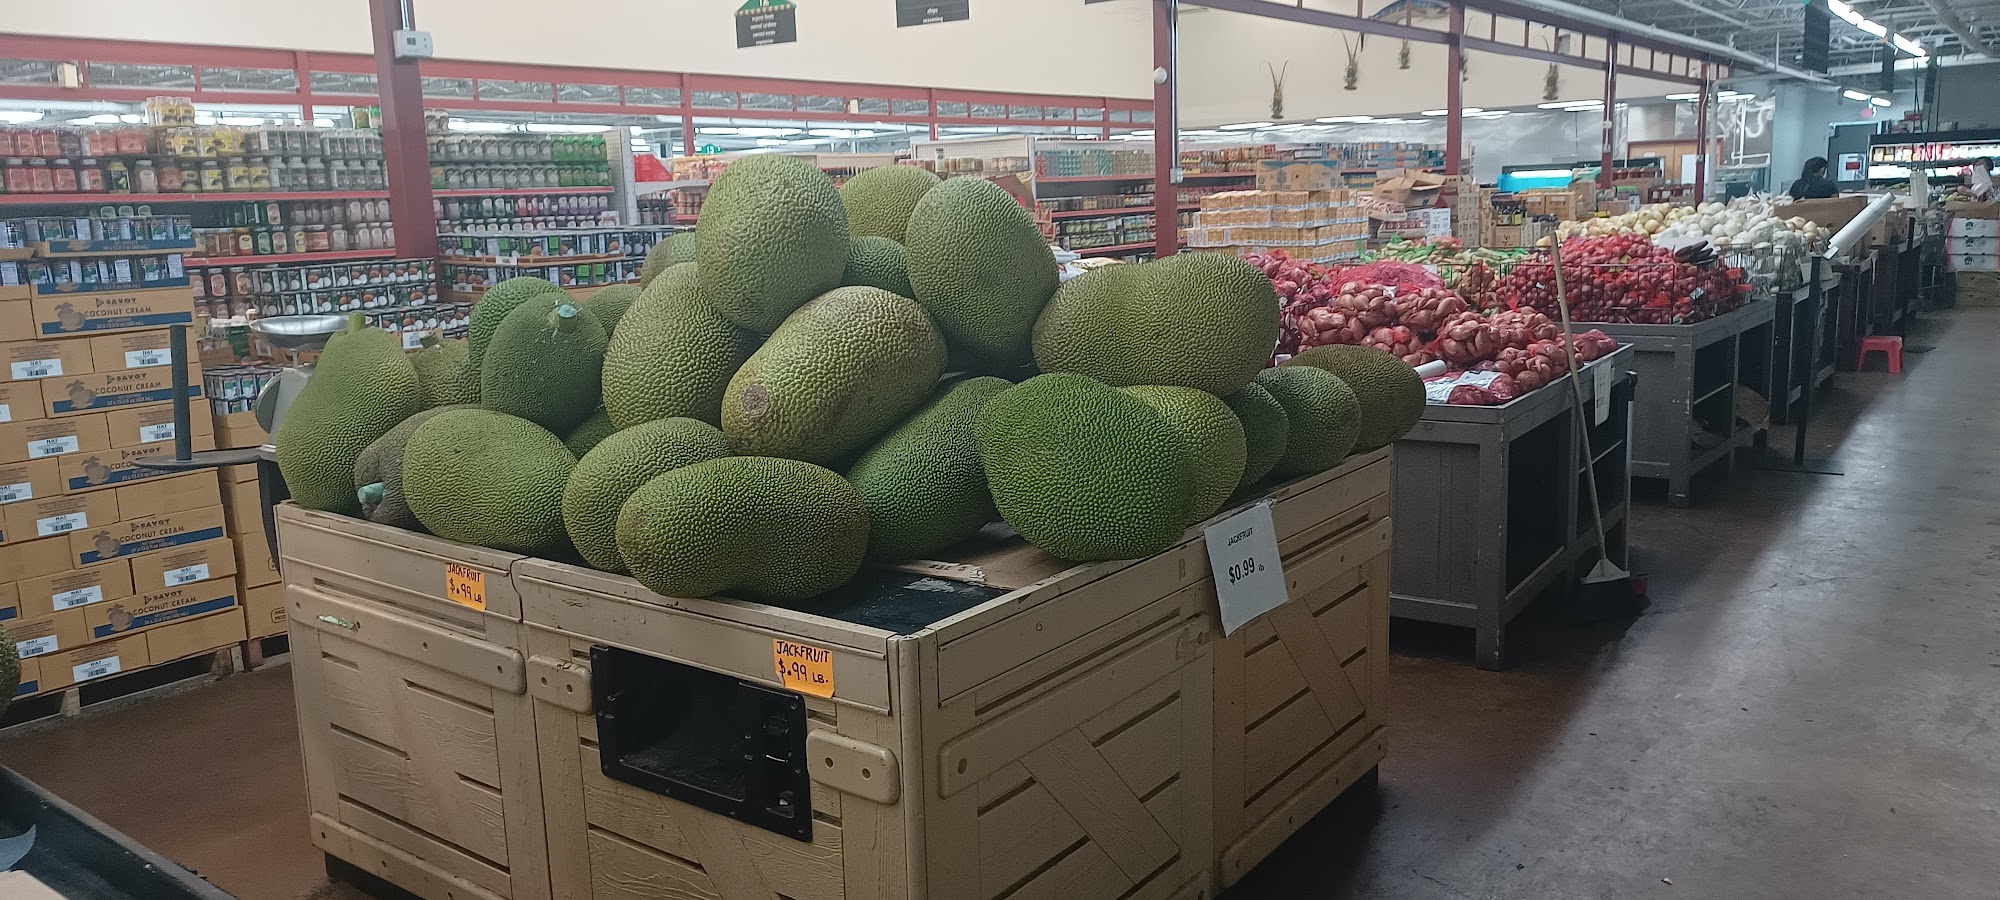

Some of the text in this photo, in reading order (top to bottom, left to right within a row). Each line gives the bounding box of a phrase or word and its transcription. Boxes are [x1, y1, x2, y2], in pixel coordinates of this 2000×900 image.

[84, 306, 152, 317] COCONUT CREAM
[116, 373, 147, 381] SAVOY
[95, 381, 161, 394] COCONUT CREAM
[131, 447, 160, 456] SAVOY
[110, 461, 132, 470] COCO
[140, 518, 170, 528] SAVOY
[120, 531, 156, 543] COCONUT
[159, 526, 185, 536] CREAM
[1227, 527, 1254, 547] JACKFRUIT
[445, 562, 481, 583] JACKFRUIT
[1228, 557, 1255, 586] $0.99
[153, 590, 183, 601] SAVOY
[449, 577, 472, 600] $.99
[133, 602, 169, 616] COCONUT
[171, 596, 197, 607] CREAM
[776, 641, 831, 663] JACKFRUIT
[778, 657, 829, 684] $.99 LB.
